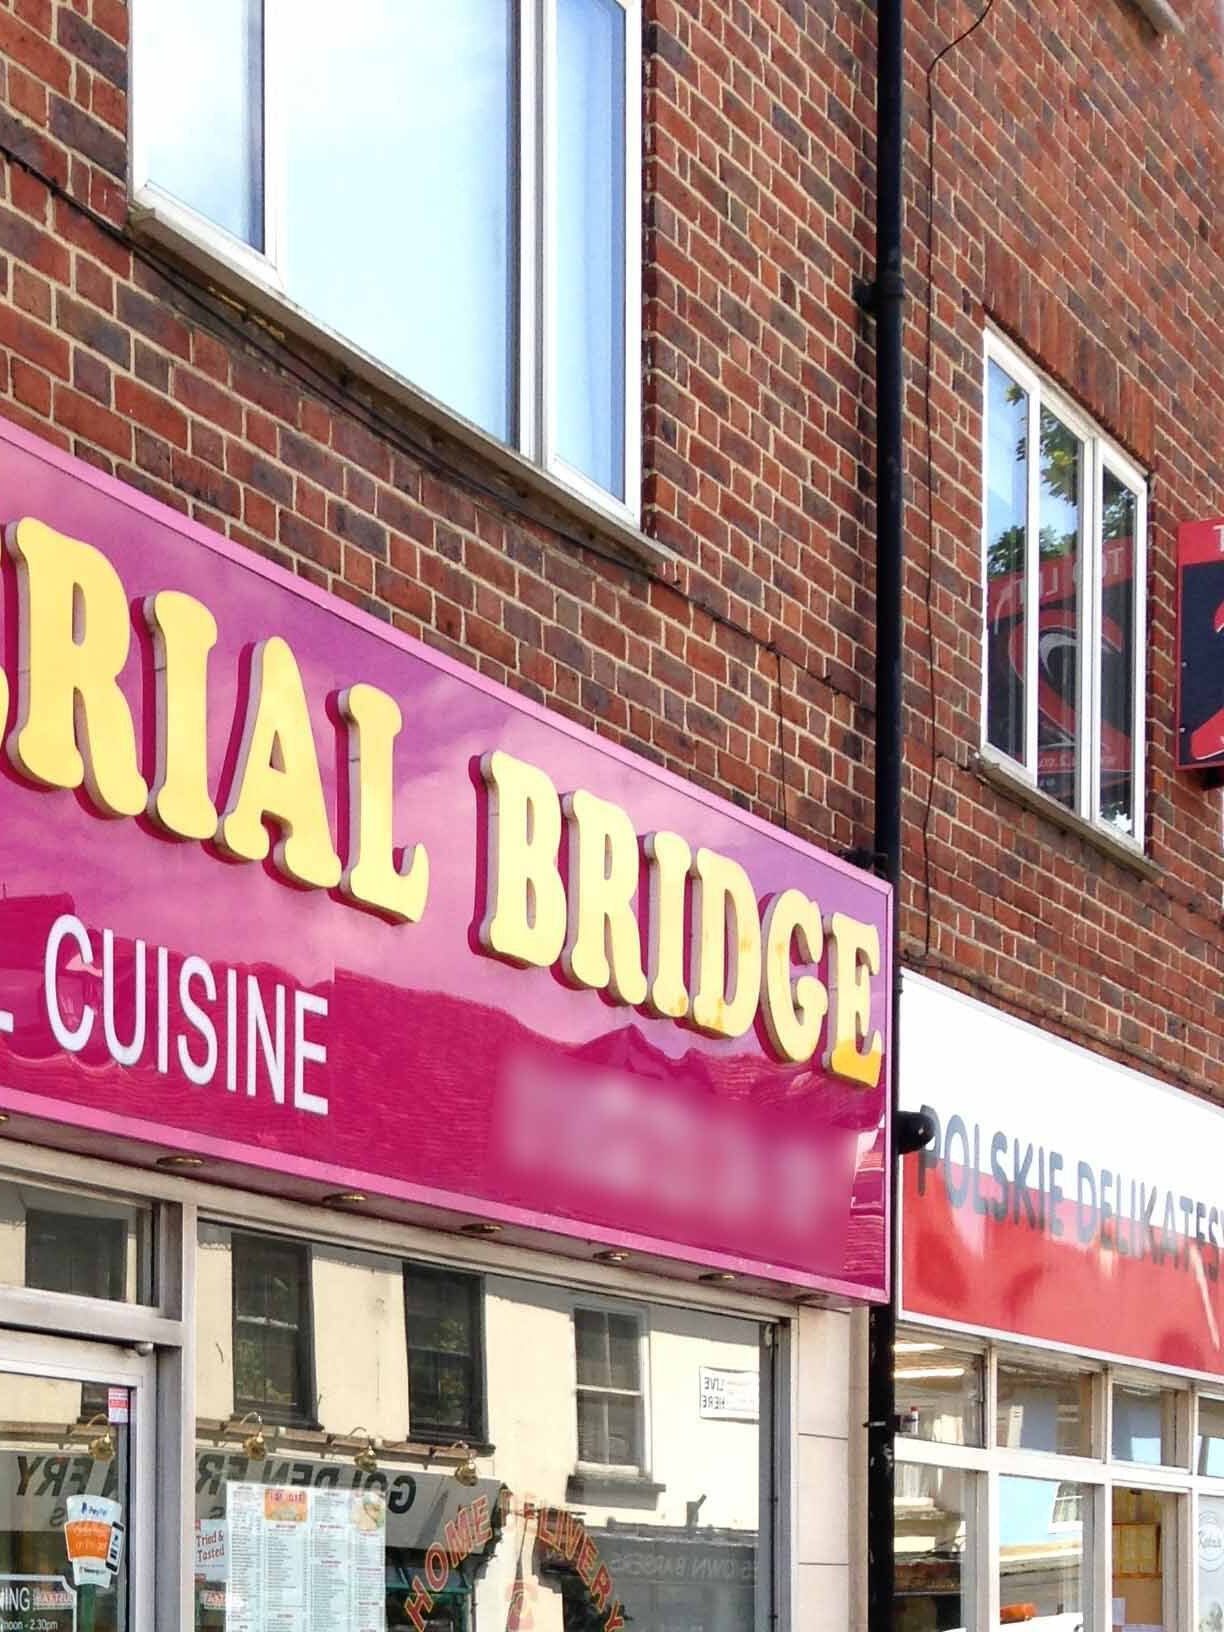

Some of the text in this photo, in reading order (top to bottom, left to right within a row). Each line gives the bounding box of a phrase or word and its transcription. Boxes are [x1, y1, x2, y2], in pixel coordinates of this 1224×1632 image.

[43, 914, 330, 1115] CUISINE
[479, 750, 884, 1088] BRIDGE
[918, 1103, 1064, 1237] POLSKIE
[1077, 1159, 1224, 1283] DELIKATES
